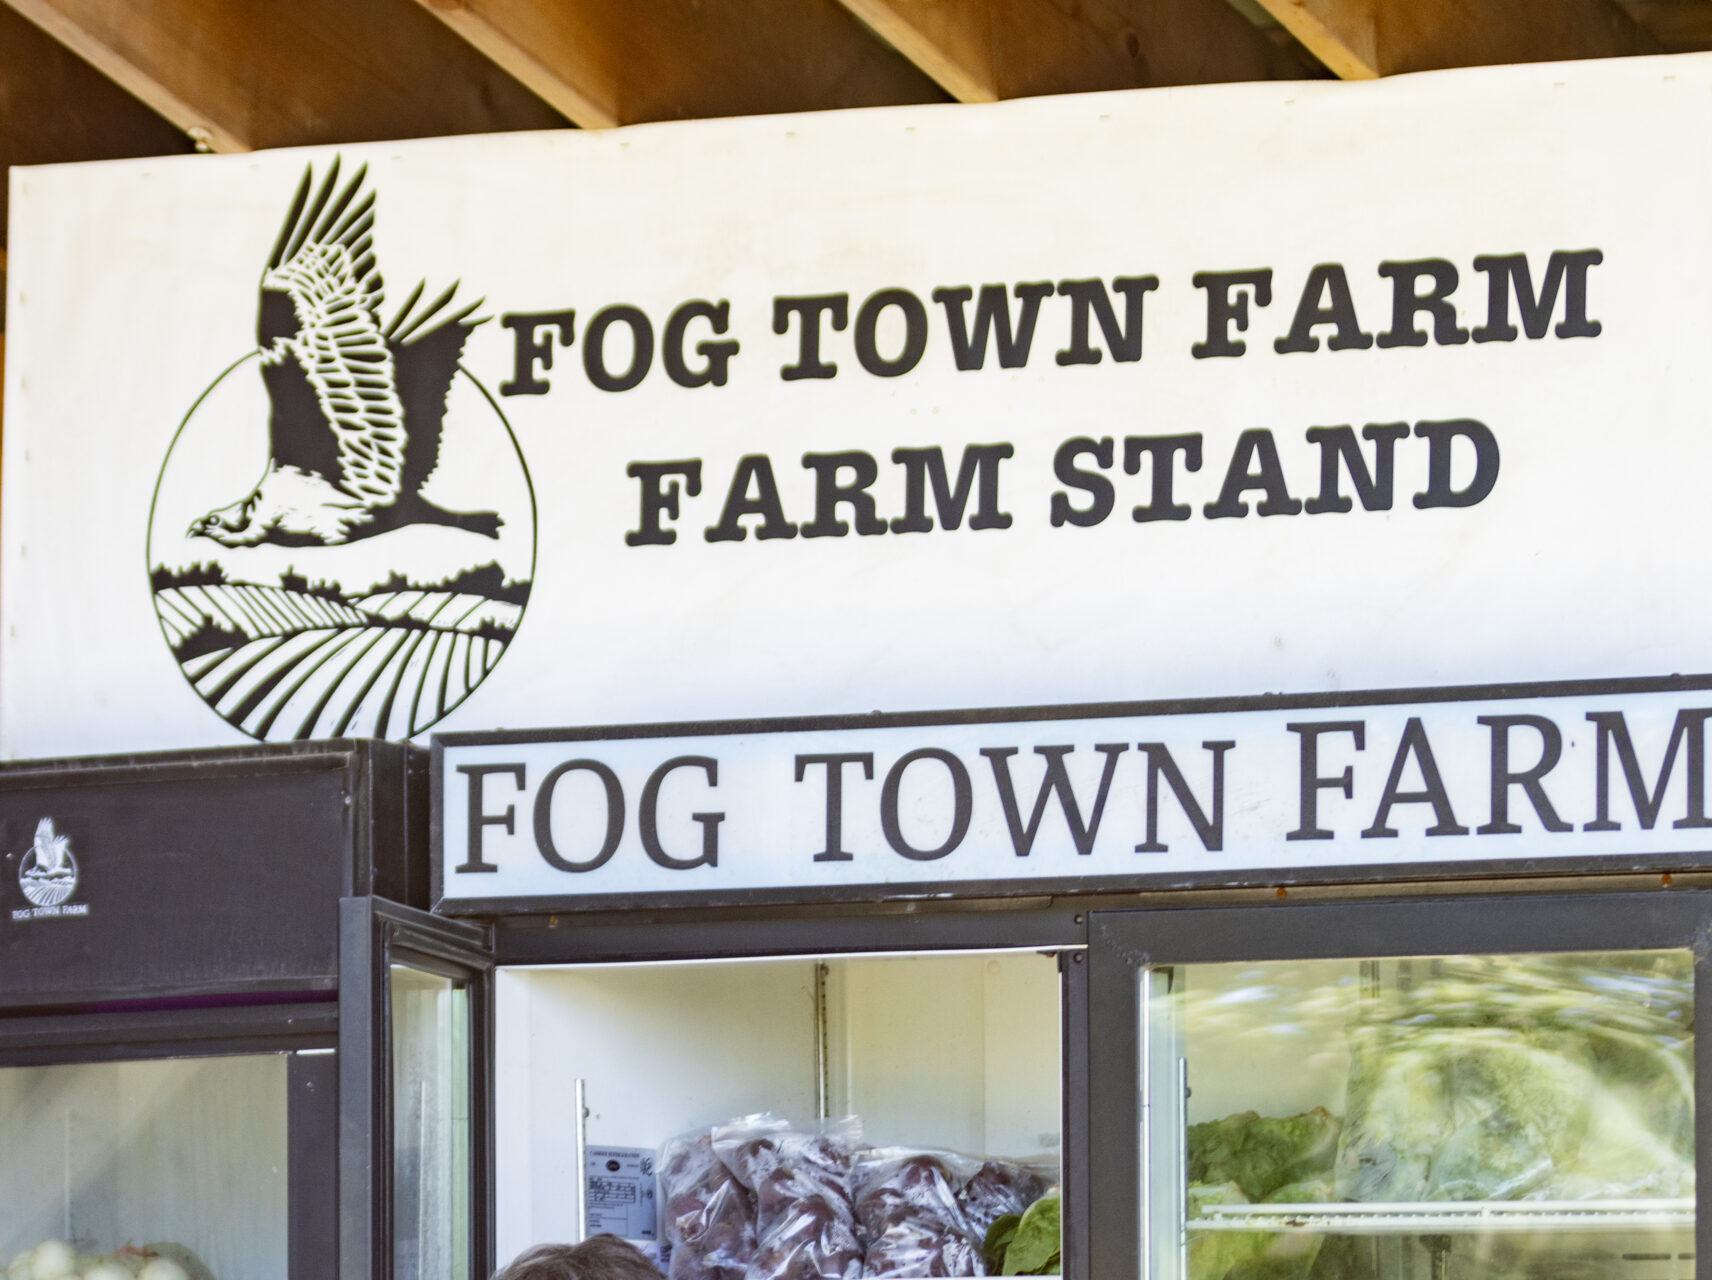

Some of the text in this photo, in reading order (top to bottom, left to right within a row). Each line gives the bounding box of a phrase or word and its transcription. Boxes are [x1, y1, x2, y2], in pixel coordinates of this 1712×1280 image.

[502, 249, 1603, 396] FOG TOWN FARM
[626, 419, 1499, 546] FARM STAND
[456, 707, 1712, 873] FOG TOWN FARM
[12, 904, 87, 919] FOG TOWN FARM
